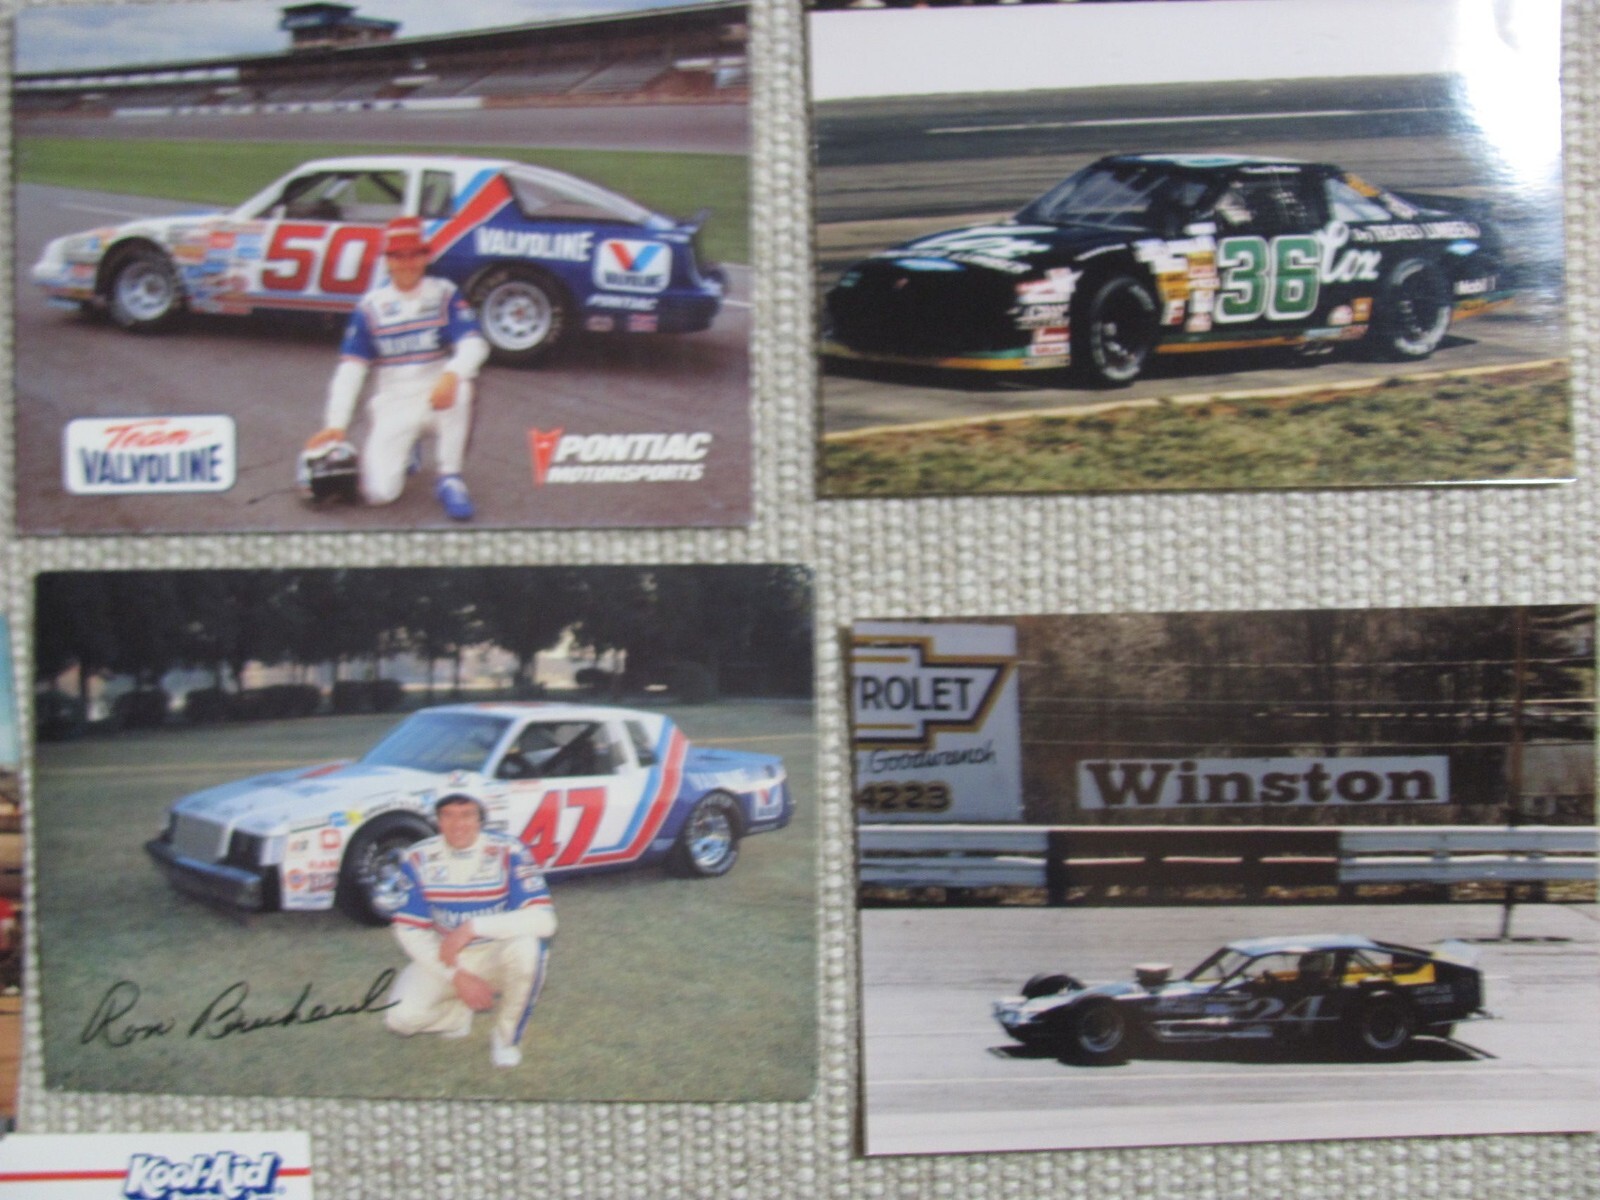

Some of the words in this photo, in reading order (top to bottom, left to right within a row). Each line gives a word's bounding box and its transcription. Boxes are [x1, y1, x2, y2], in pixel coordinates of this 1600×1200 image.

[261, 223, 385, 294] 50
[475, 226, 594, 262] VALVOLINE
[1317, 219, 1382, 283] Cox
[1213, 235, 1321, 324] 36
[103, 418, 213, 451] Team
[553, 431, 713, 463] PONTIAC
[78, 442, 225, 486] VALVOLINE
[546, 463, 706, 484] MOTORSPORTS
[853, 675, 975, 712] ROLET
[1087, 760, 1438, 806] Winston
[519, 786, 607, 868] 47
[124, 1150, 283, 1200] Kool-Aid
